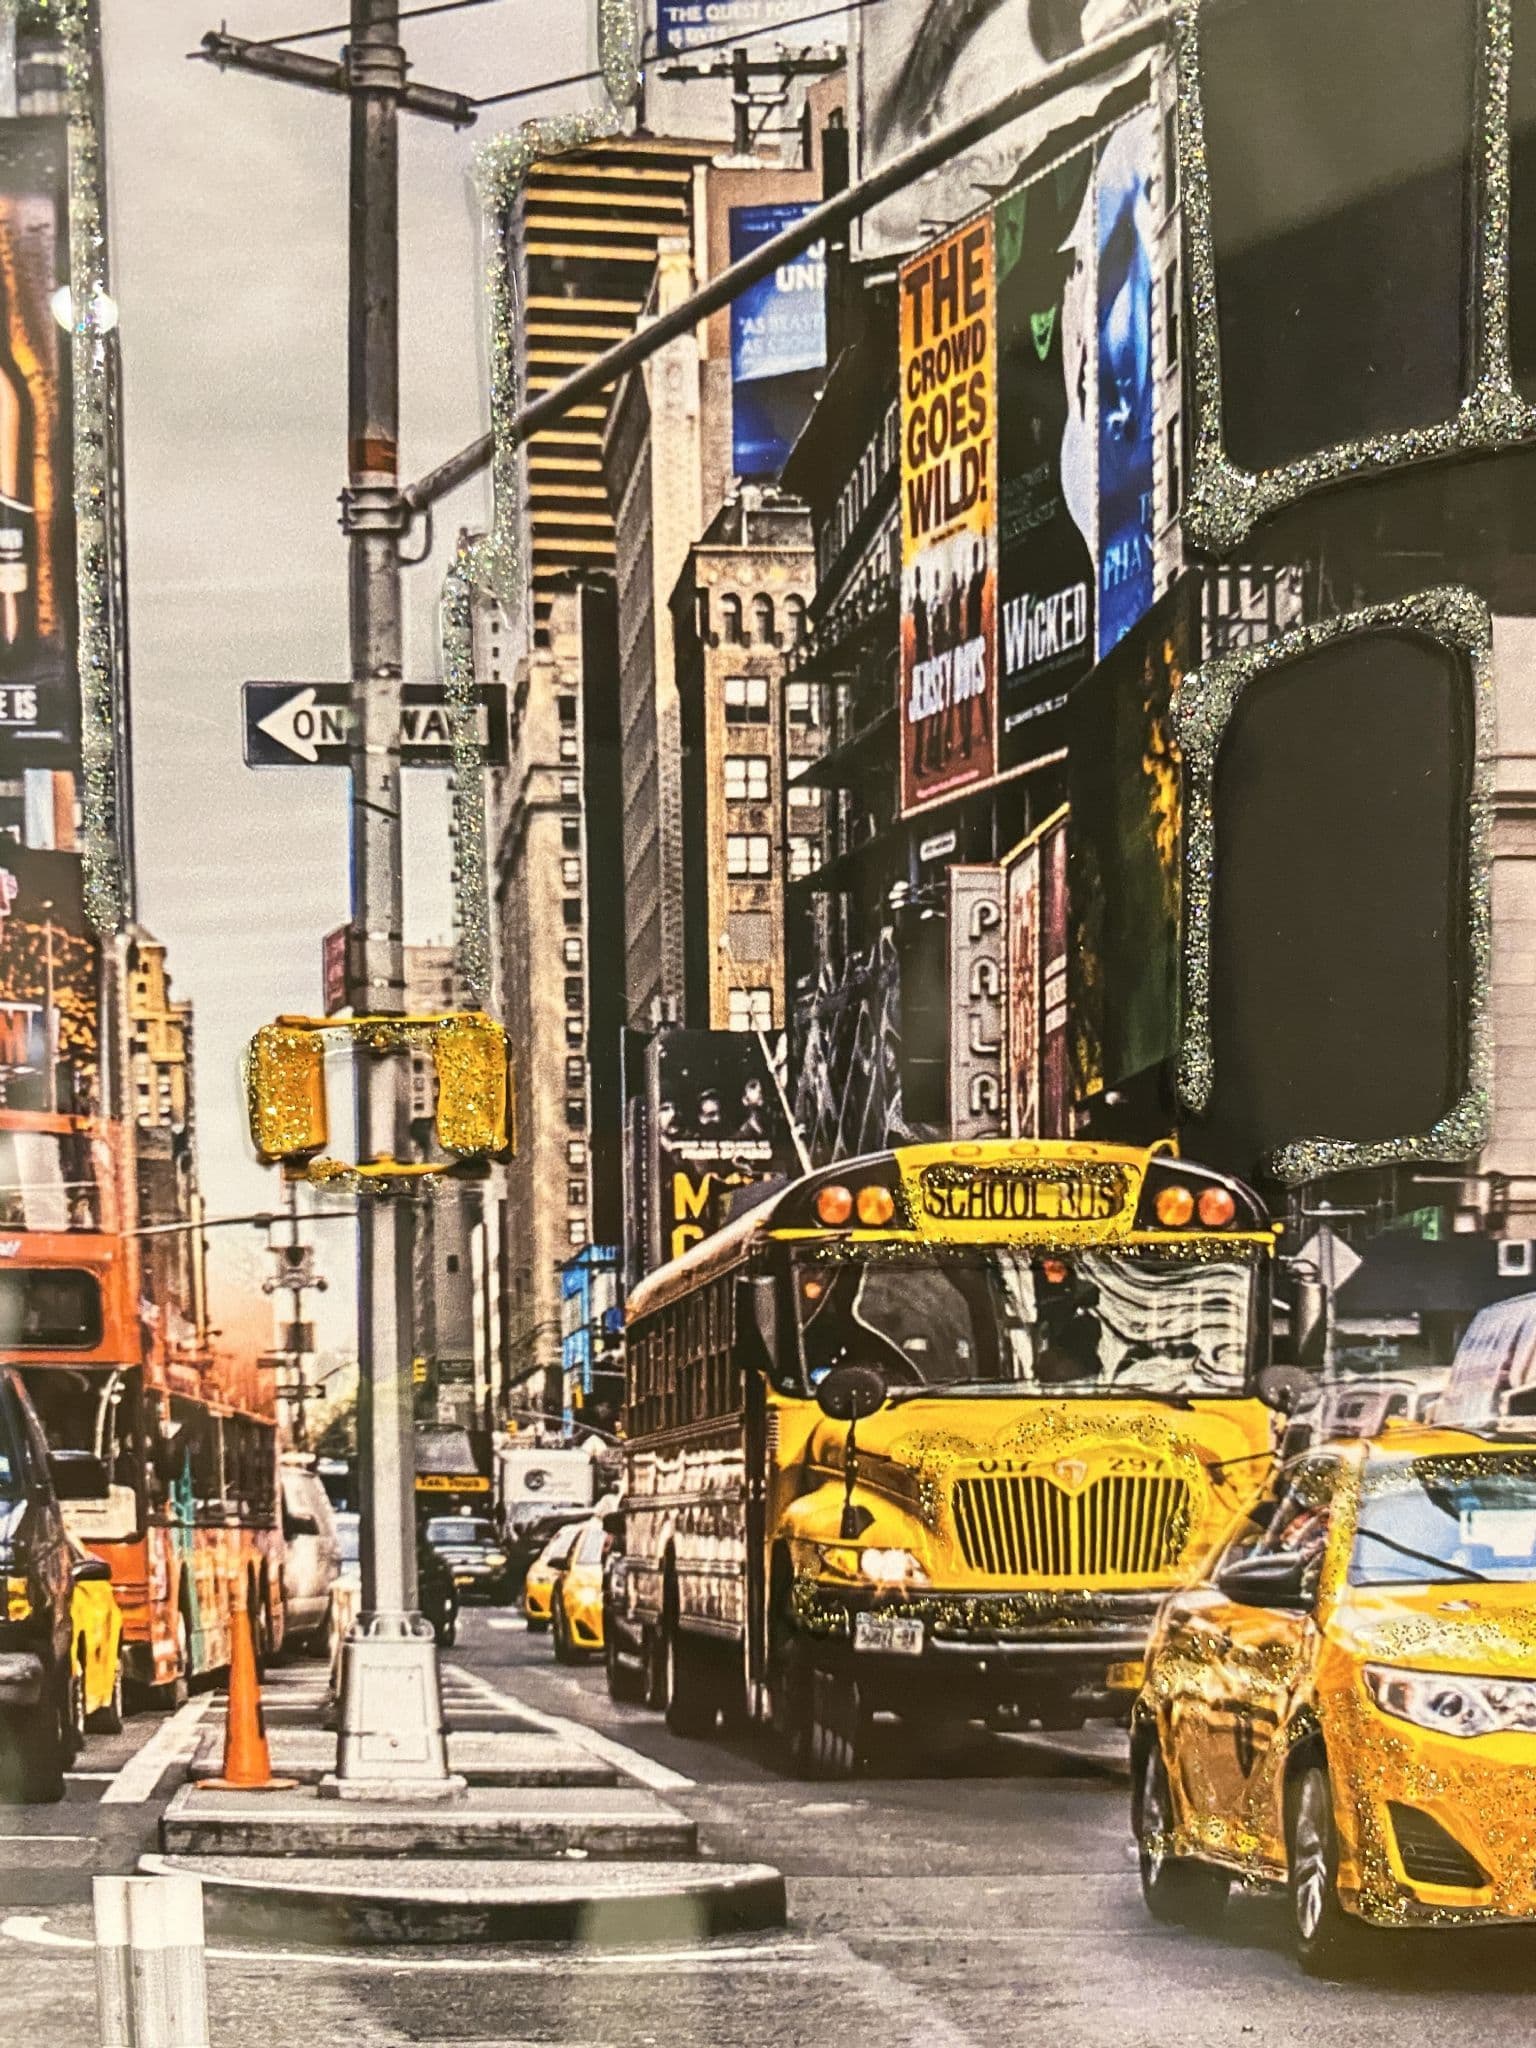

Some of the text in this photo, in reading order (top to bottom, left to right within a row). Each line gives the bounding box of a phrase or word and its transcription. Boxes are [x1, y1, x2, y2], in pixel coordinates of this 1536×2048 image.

[904, 227, 986, 348] THE
[907, 318, 986, 401] CROWD
[907, 371, 986, 470] GOES
[908, 438, 991, 538] WILD!
[293, 709, 345, 741] ON
[924, 1178, 1117, 1219] SCHOOL BUS
